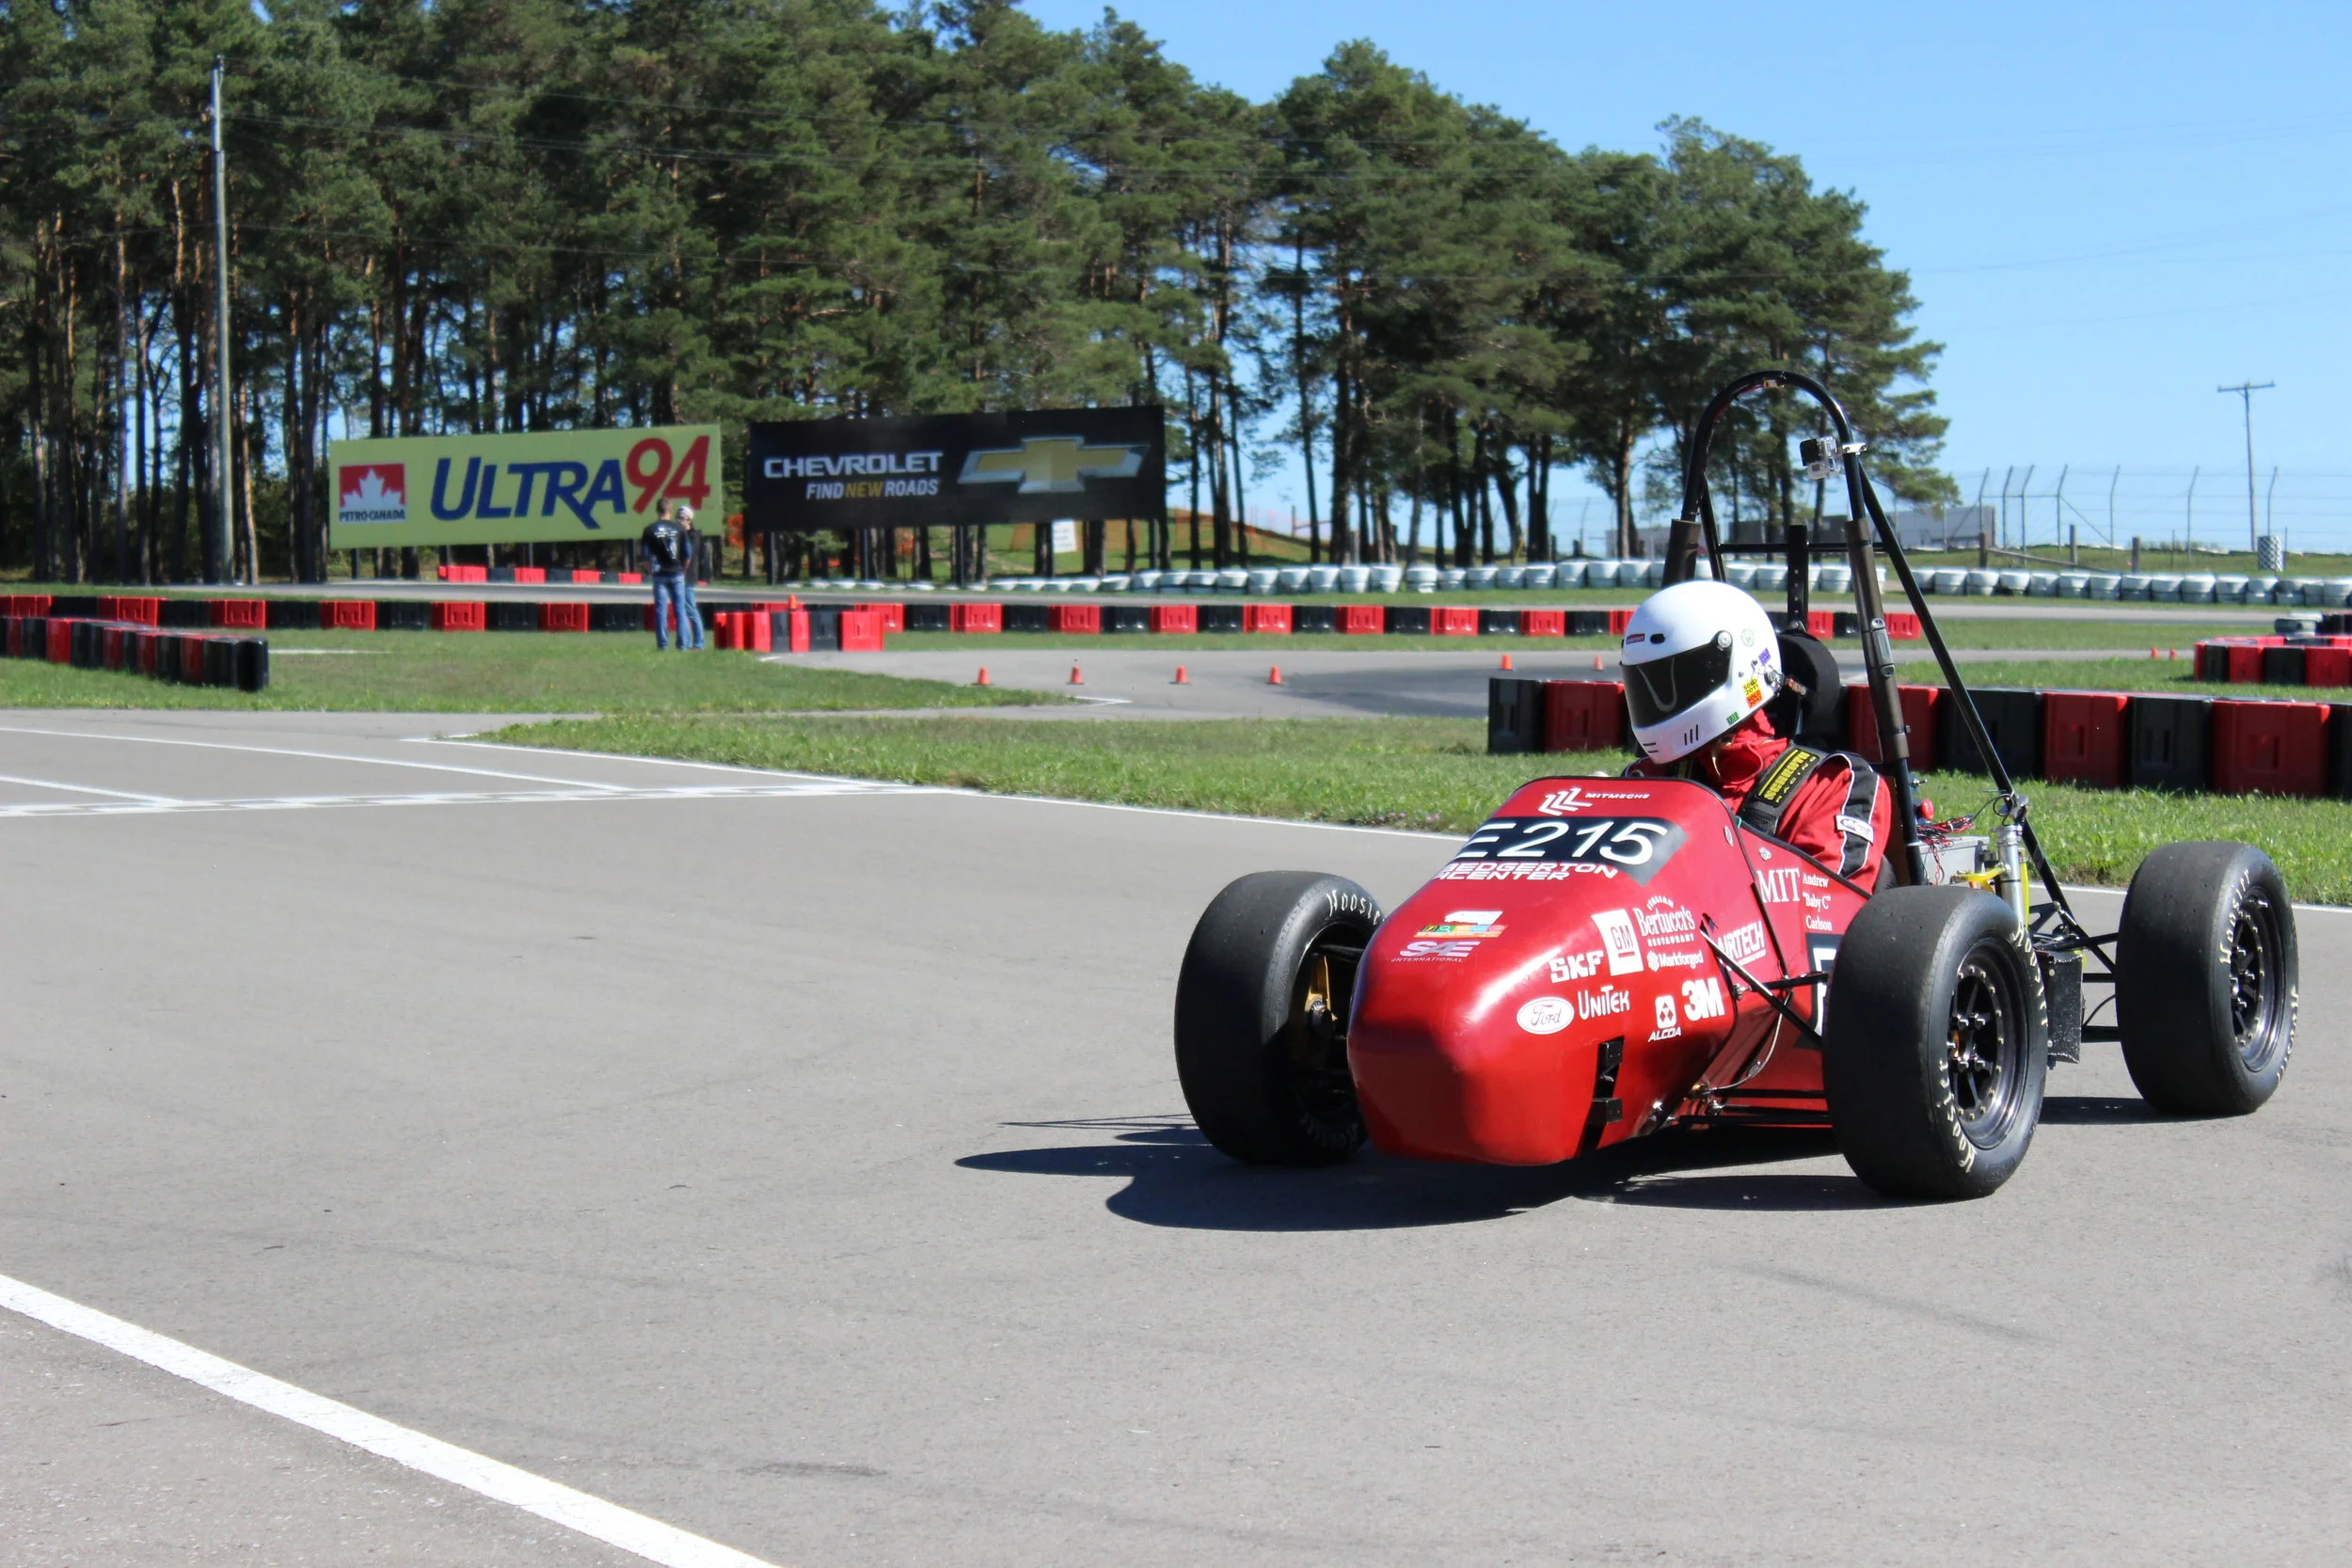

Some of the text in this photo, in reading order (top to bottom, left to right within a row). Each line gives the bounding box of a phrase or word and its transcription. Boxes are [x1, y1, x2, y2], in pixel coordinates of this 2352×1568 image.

[626, 436, 712, 515] 94
[764, 451, 944, 478] CHEVROLET
[806, 479, 939, 500] FIND NEW ROADS
[1454, 821, 1669, 865] E215
[1756, 868, 1801, 903] MIT
[1803, 873, 1830, 888] Andrew
[1632, 905, 1696, 937] Bertucci's
[1805, 915, 1833, 931] Carlson
[1400, 941, 1481, 958] SAE
[1610, 926, 1634, 951] GM
[1549, 950, 1605, 983] SKF
[1658, 949, 1705, 970] Markforged
[1681, 976, 1725, 1022] 3M
[1530, 1004, 1562, 1026] Ford
[1648, 1027, 1682, 1043] ALCOA
